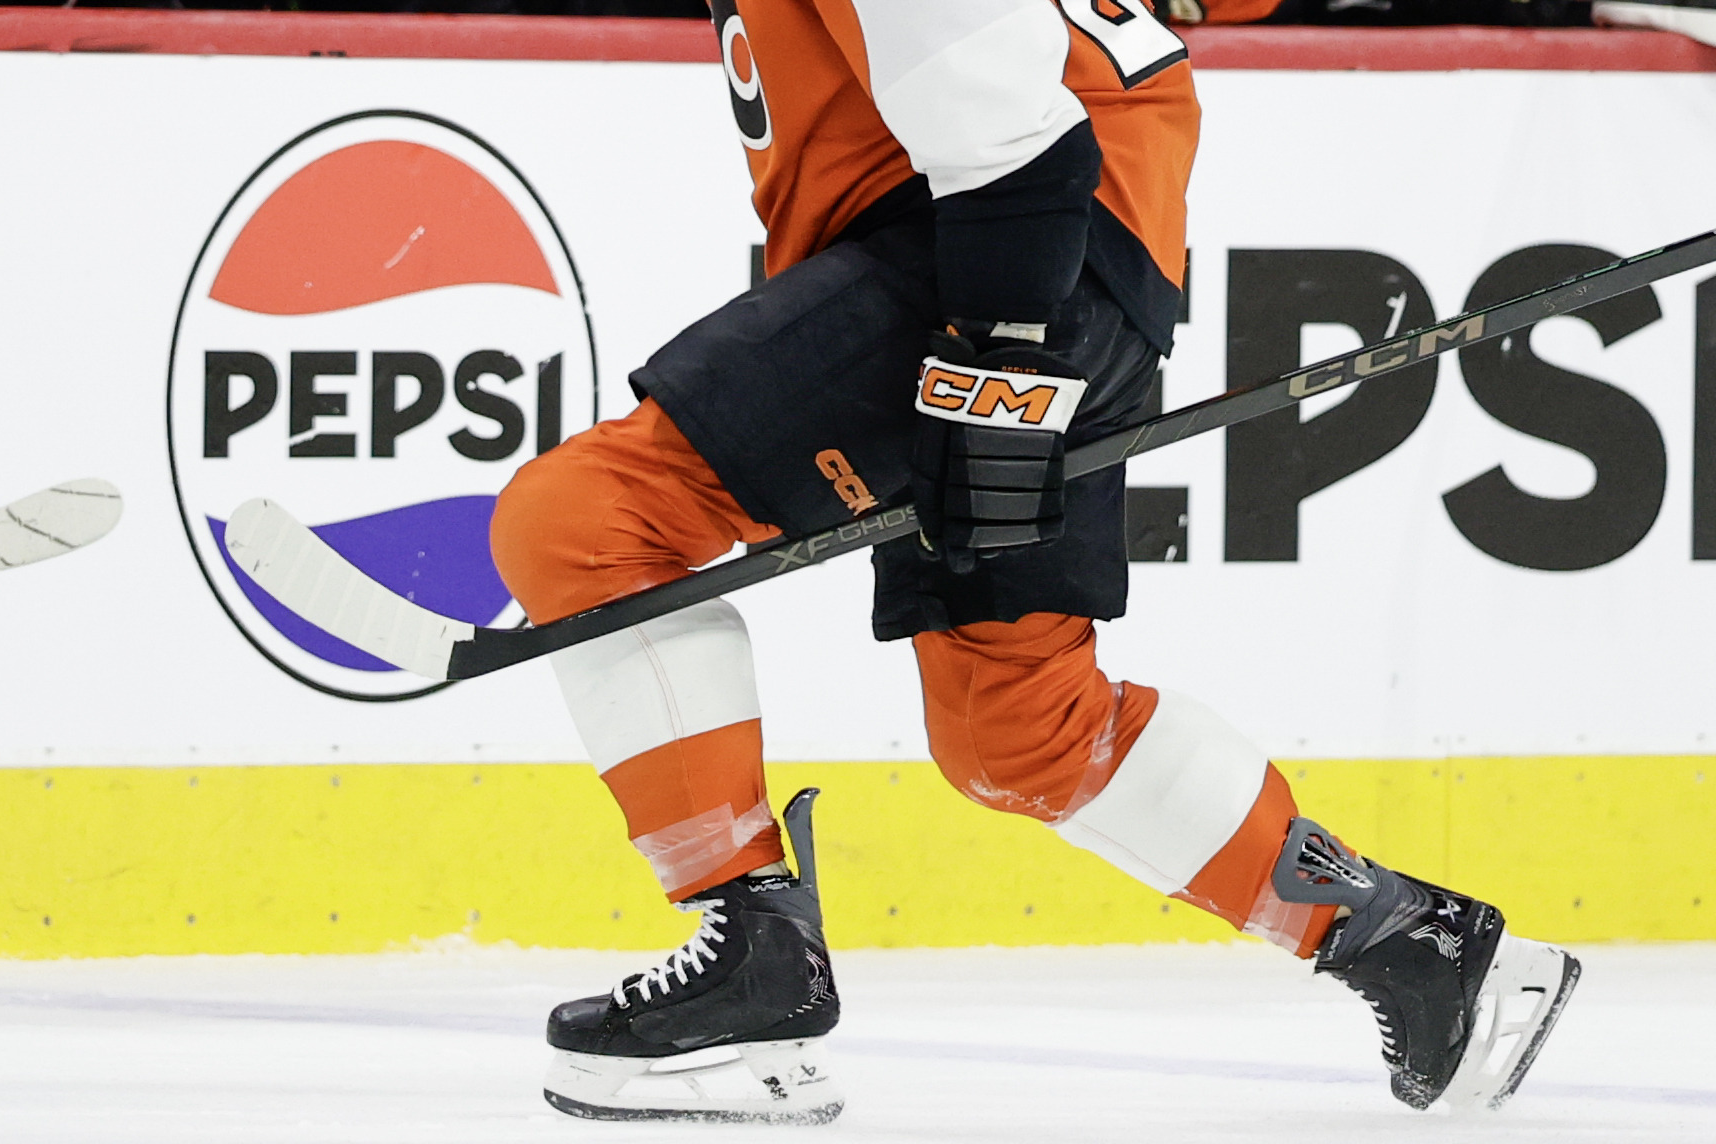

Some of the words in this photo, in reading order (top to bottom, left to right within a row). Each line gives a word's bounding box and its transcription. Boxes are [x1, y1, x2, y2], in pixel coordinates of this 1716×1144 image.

[919, 366, 1059, 426] CM
[1288, 313, 1487, 399] CCM
[202, 348, 565, 463] PEPSI
